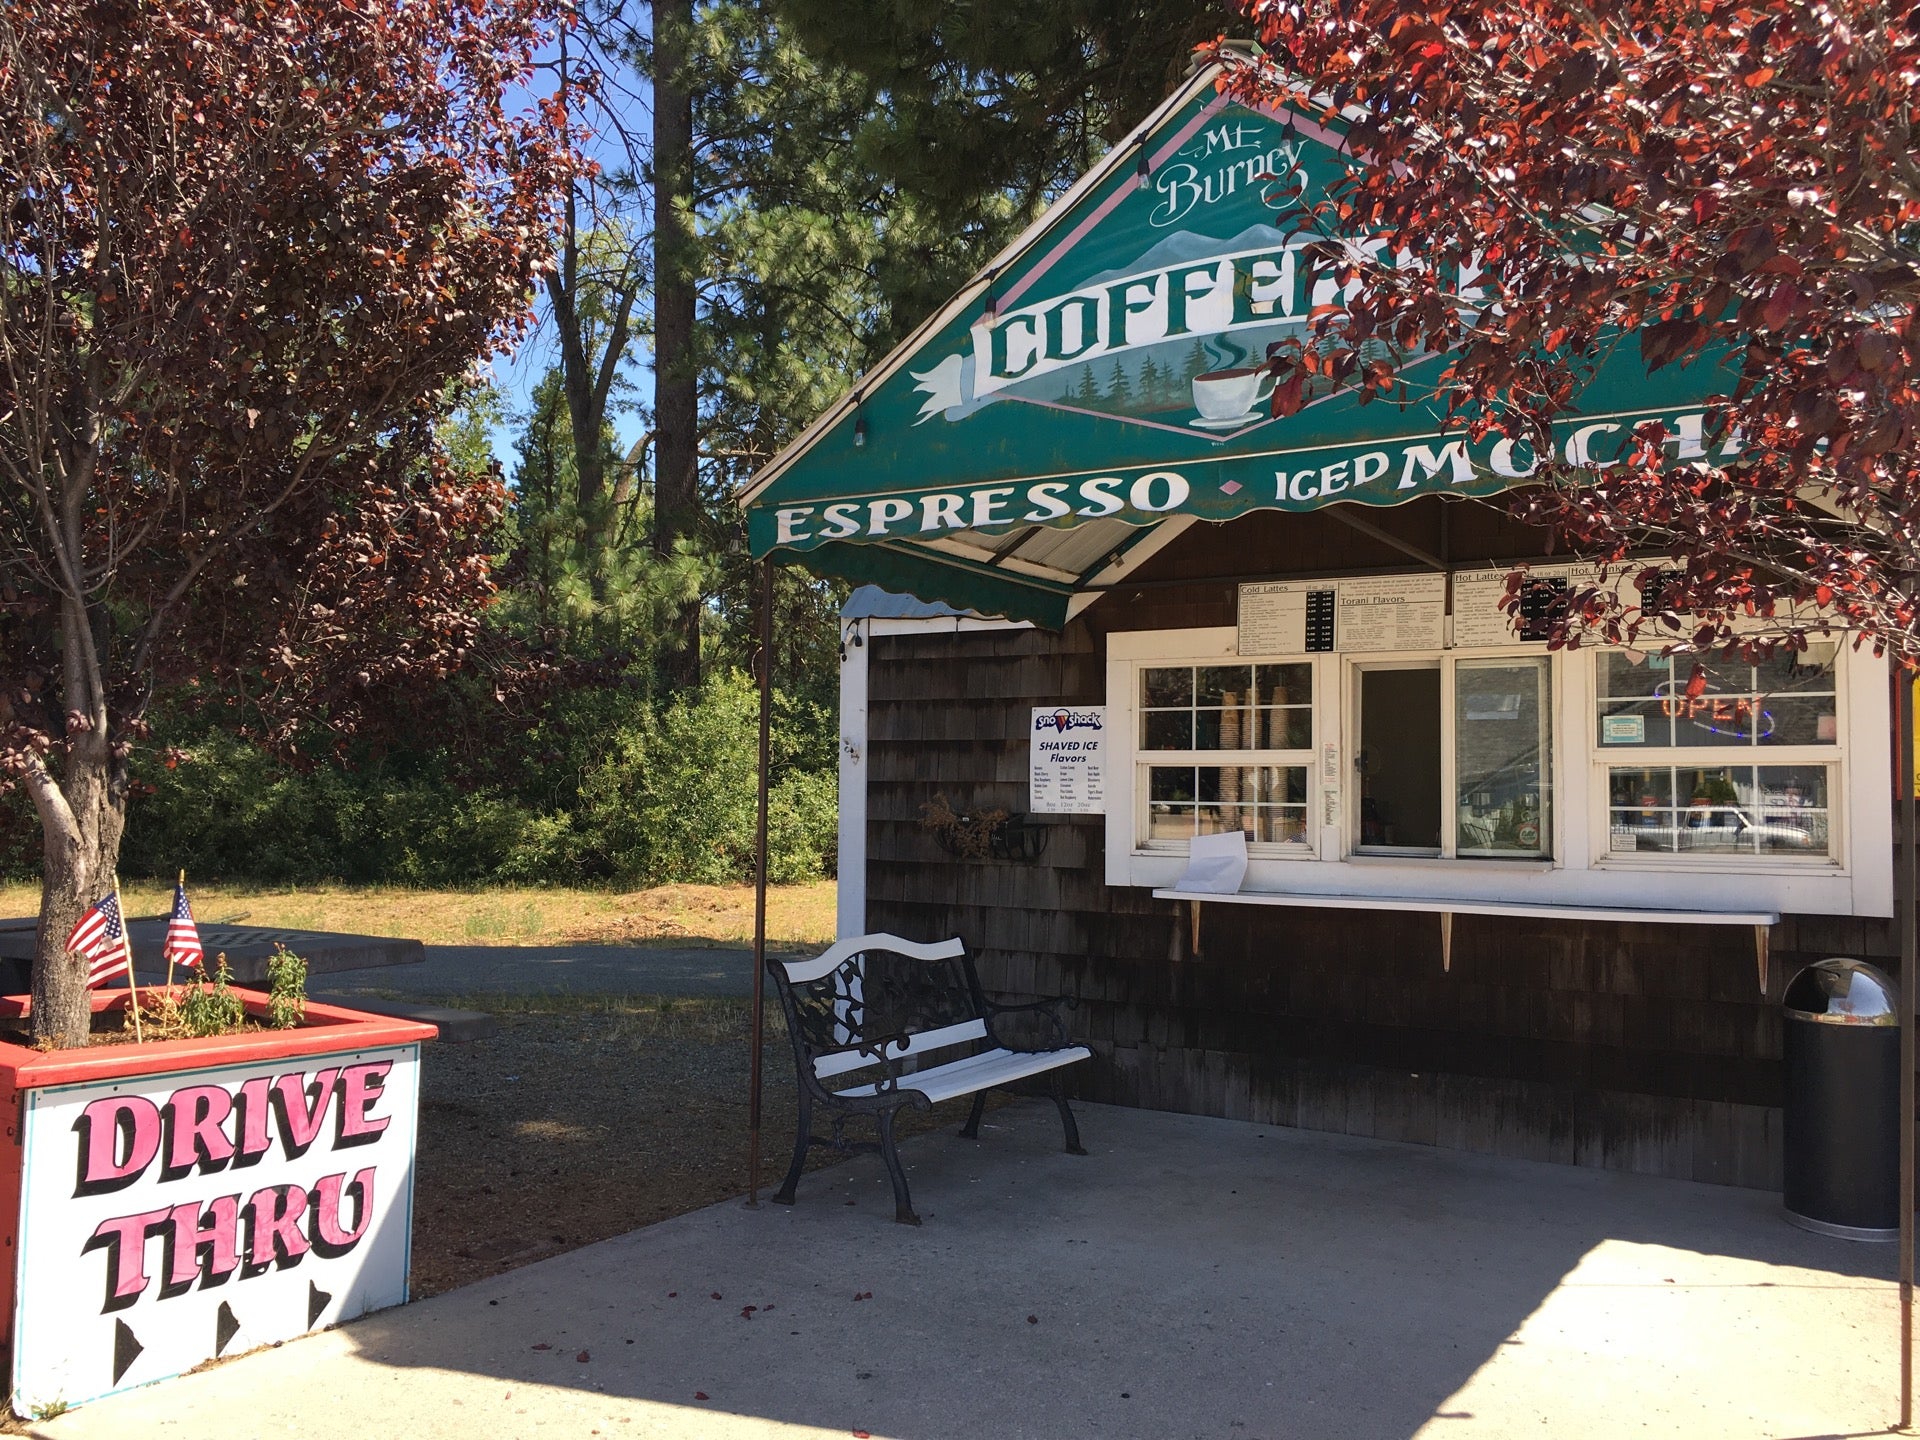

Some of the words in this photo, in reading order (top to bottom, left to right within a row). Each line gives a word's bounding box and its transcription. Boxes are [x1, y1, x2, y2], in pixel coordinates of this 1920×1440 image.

[1149, 138, 1310, 228] Burney
[774, 471, 1191, 545] ESPRESSO
[1275, 451, 1389, 500] ICED
[1396, 411, 1830, 491] MOCH
[1571, 566, 1589, 575] Hot
[1594, 563, 1627, 574] Dnk
[1455, 574, 1472, 582] Hot
[1476, 573, 1505, 581] Lattes
[1241, 585, 1260, 594] Cold
[1263, 584, 1289, 593] Lattes
[1341, 596, 1370, 605] Torani
[1373, 595, 1406, 604] Flavors
[1661, 693, 1762, 721] OPEN
[1066, 711, 1103, 730] shack
[1039, 741, 1080, 751] SHAVED
[1082, 741, 1099, 750] ICE
[1050, 753, 1087, 763] Flavors
[71, 1059, 394, 1199] DRIVE
[80, 1165, 378, 1316] THRU
